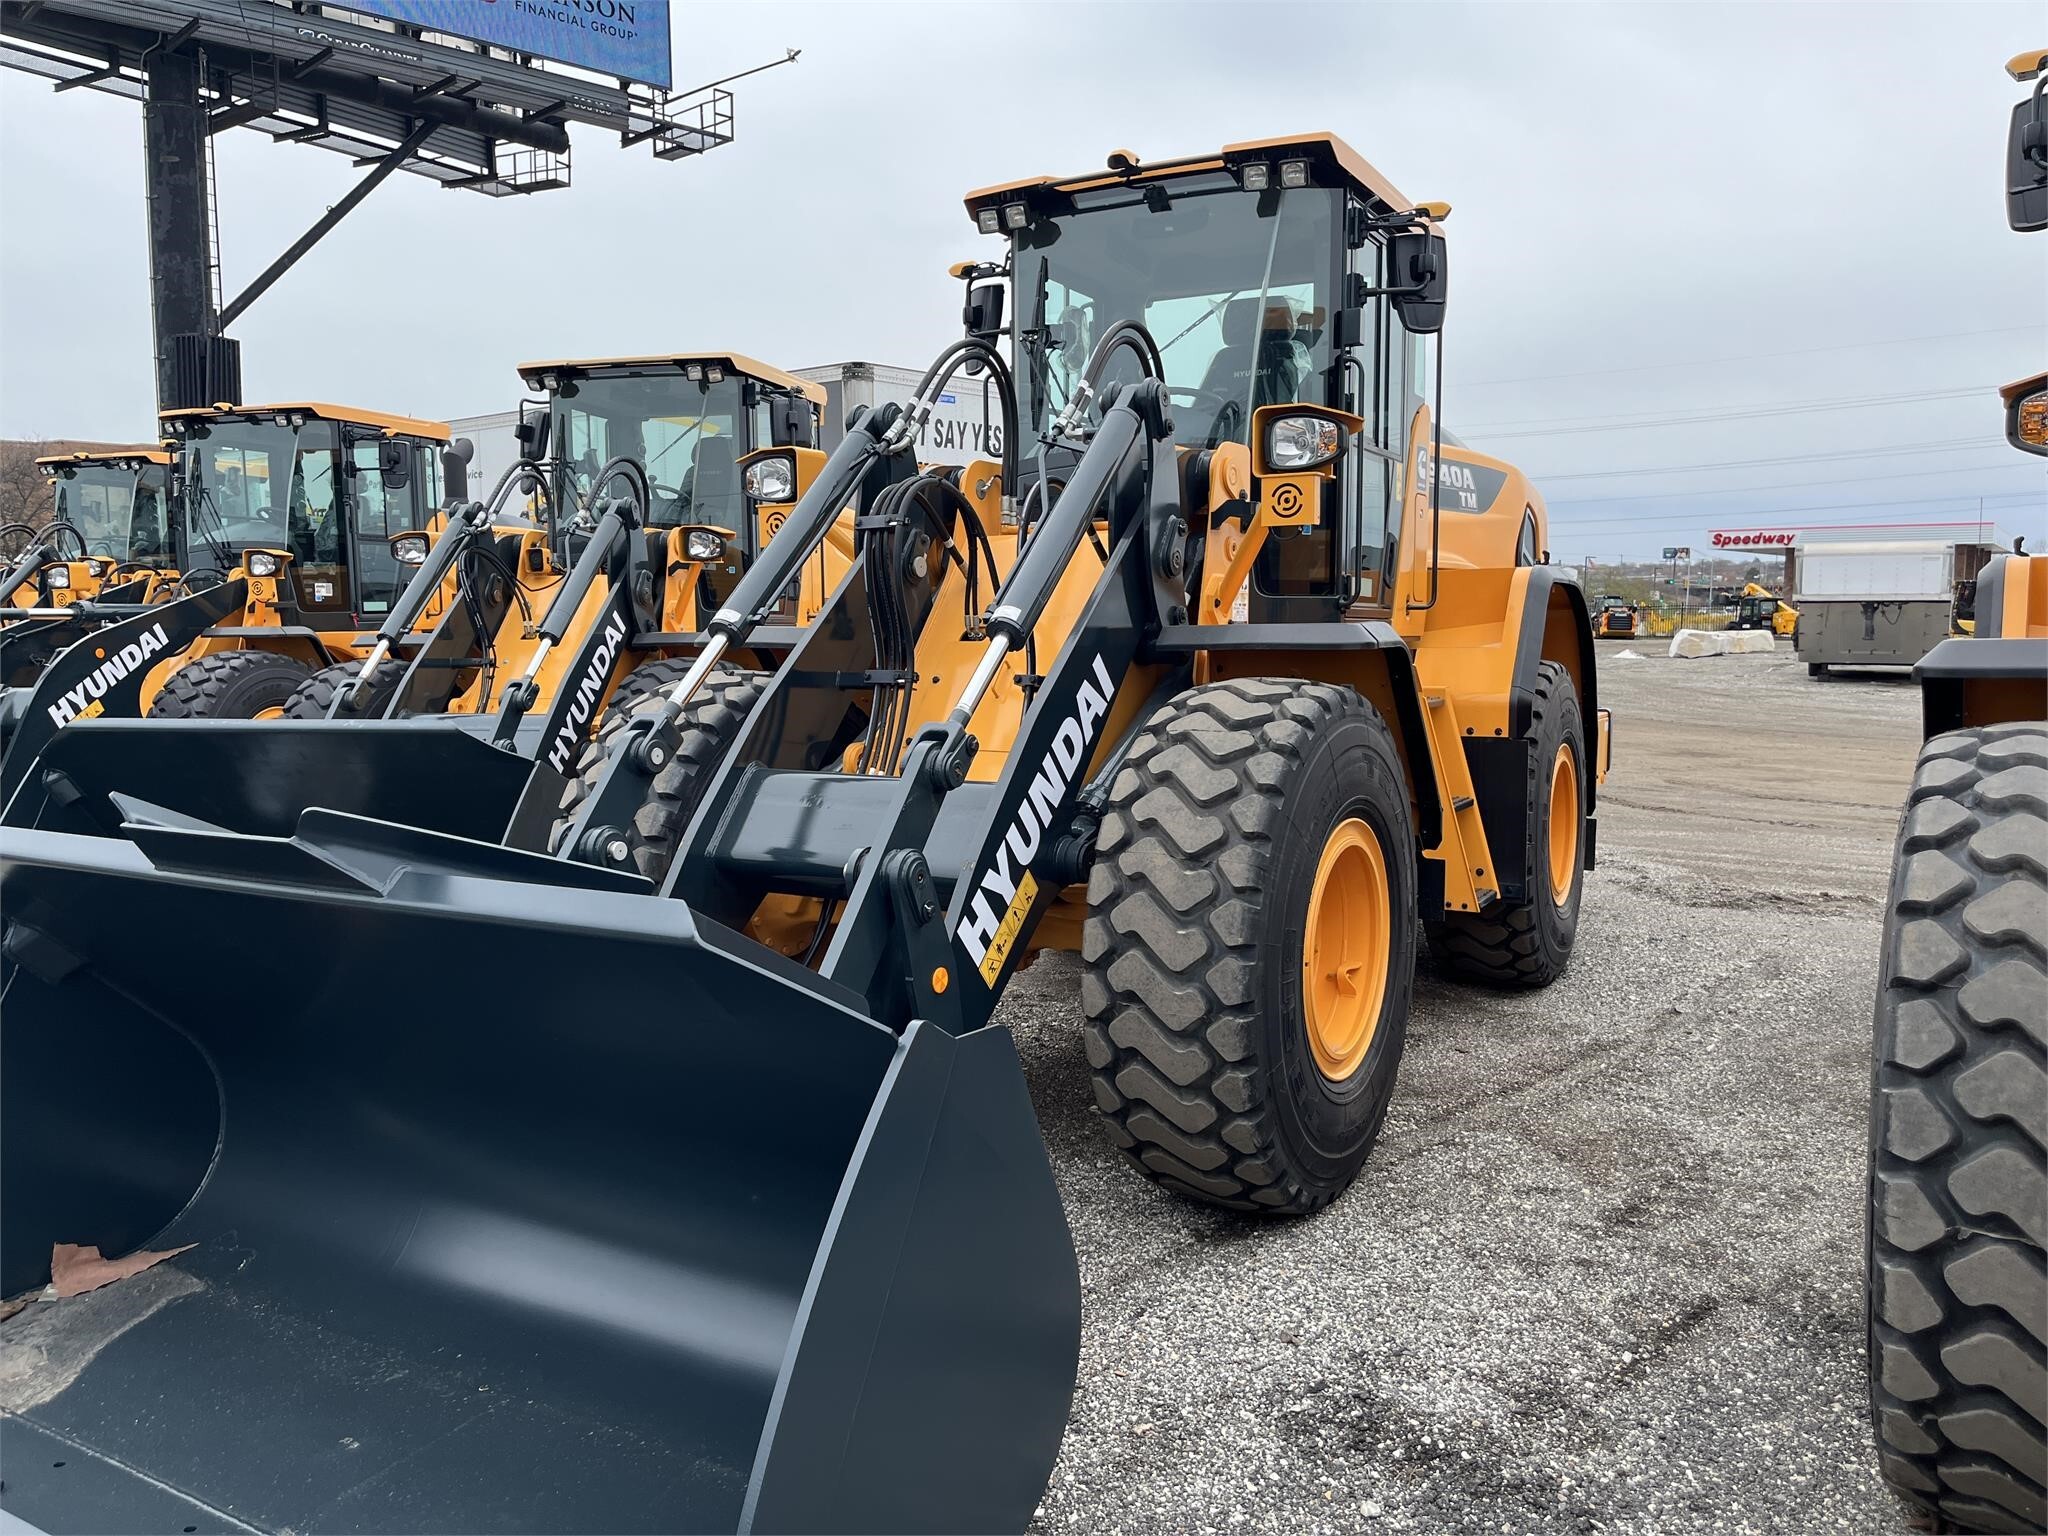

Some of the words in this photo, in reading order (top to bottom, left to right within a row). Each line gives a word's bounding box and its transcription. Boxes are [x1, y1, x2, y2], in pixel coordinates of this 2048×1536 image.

[515, 3, 586, 29] FINANCIAL
[933, 418, 968, 450] SAY
[1458, 491, 1477, 509] TM
[1711, 532, 1795, 548] Speedway
[47, 622, 170, 730] HYUNDAI
[548, 609, 627, 775] HYUNDAI
[956, 652, 1115, 968] HYUNDAI
